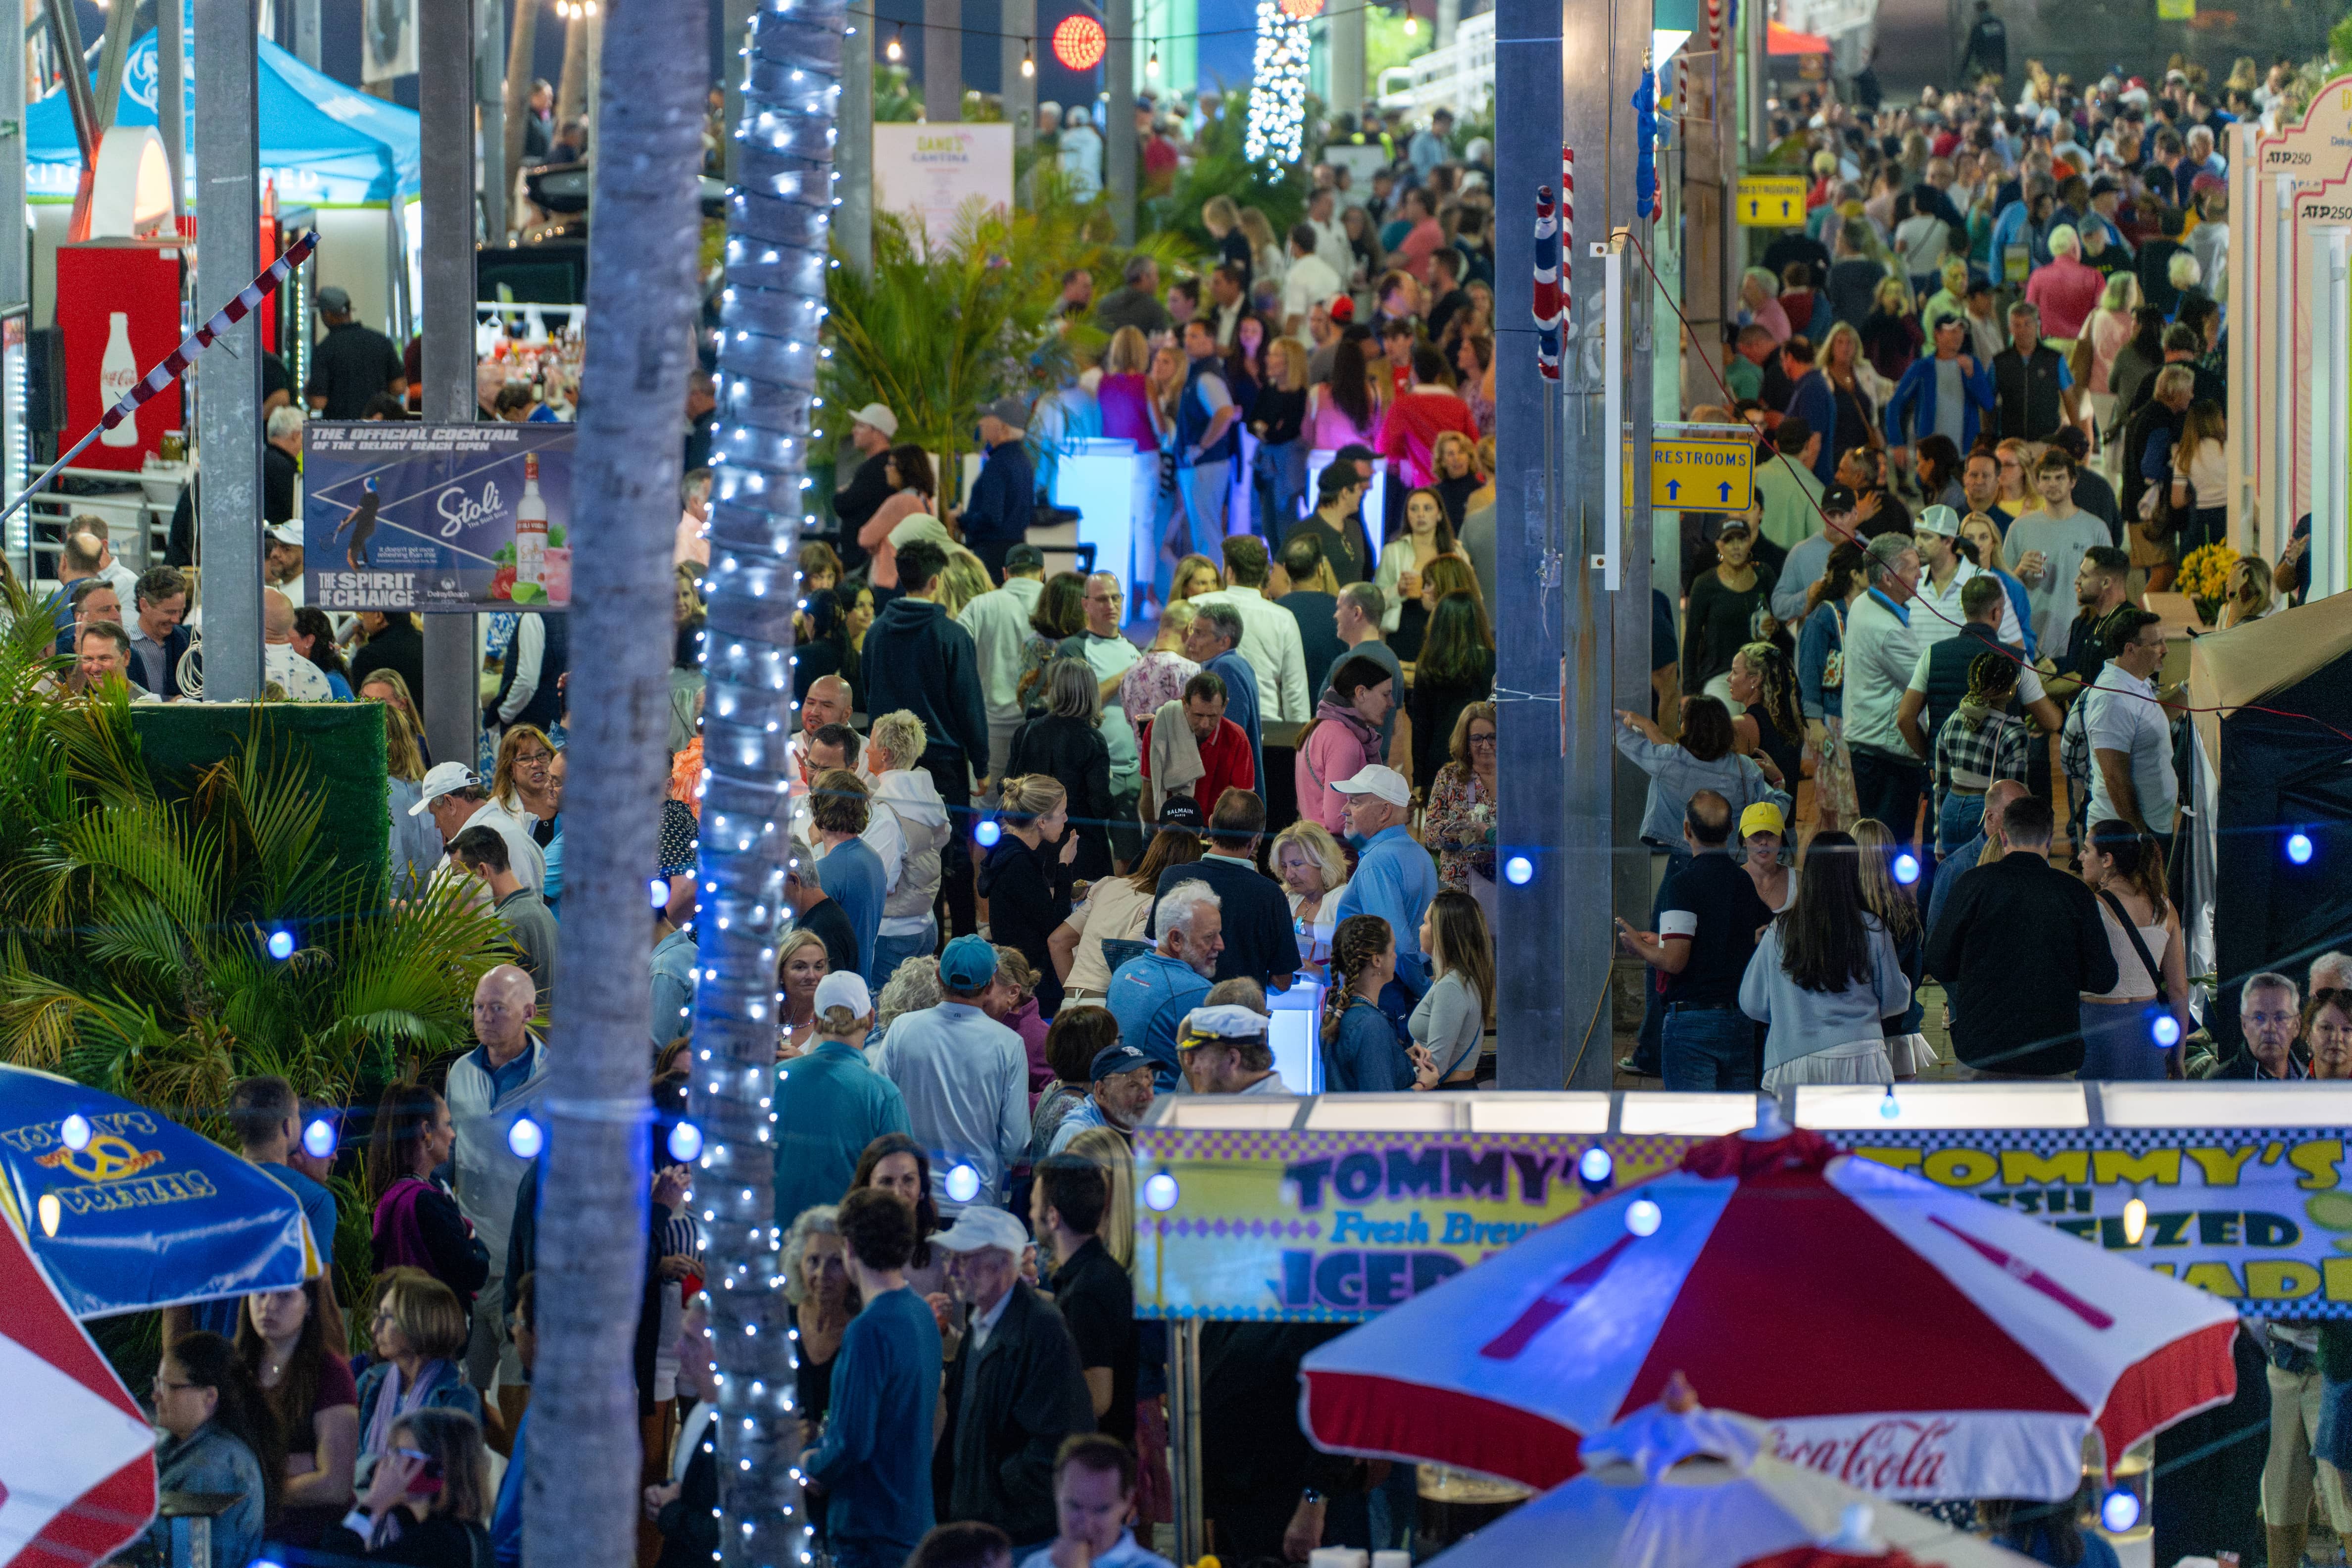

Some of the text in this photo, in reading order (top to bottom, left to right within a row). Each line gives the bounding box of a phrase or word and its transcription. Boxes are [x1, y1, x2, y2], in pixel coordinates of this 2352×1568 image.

[312, 428, 519, 441] THE OFFICIAL COCKTAIL
[312, 441, 490, 451] OF THE DELRAY BEACH OPEN
[1654, 450, 1747, 467] RESTROOMS
[437, 480, 502, 537] Stoli
[318, 572, 416, 589] THE SPIRIT
[319, 589, 415, 607] OF CHANGE
[1329, 1209, 1430, 1244] Fresh
